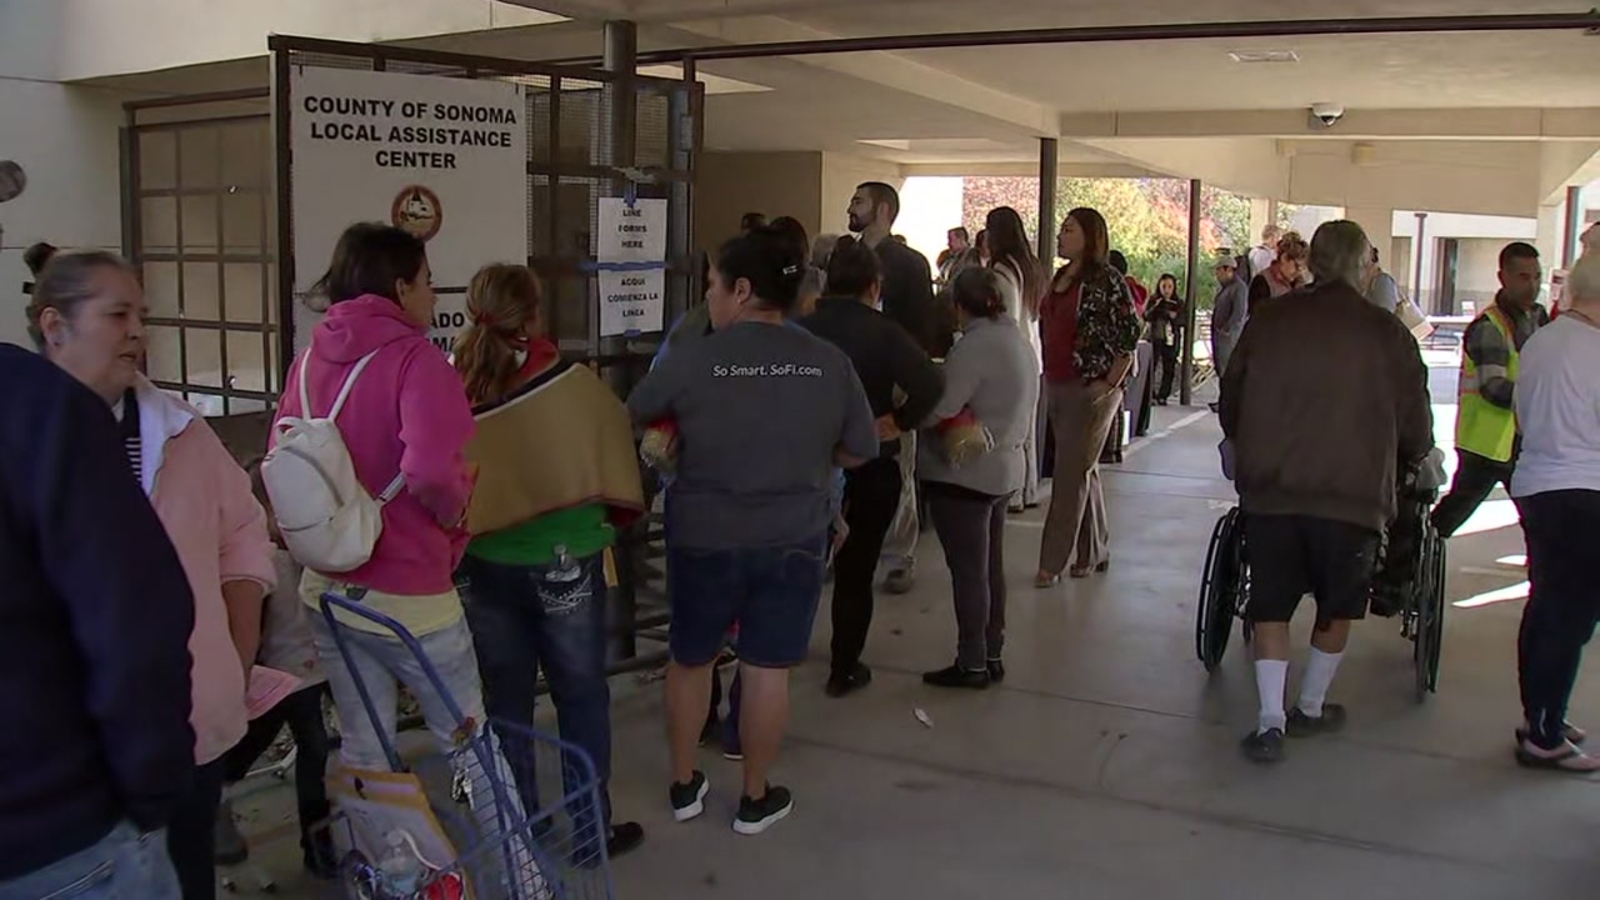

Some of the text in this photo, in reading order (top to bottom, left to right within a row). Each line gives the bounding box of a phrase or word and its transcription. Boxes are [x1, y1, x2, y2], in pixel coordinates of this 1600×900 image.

[304, 96, 516, 124] COUNTY OF SONOMA
[311, 122, 511, 147] LOCAL ASSISTANCE
[375, 150, 456, 169] CENTER
[622, 209, 641, 217] LINE
[618, 225, 647, 233] FORMS
[621, 241, 643, 249] HERE
[607, 294, 647, 303] COMIENZA
[713, 365, 728, 376] So
[730, 365, 767, 376] Smart.
